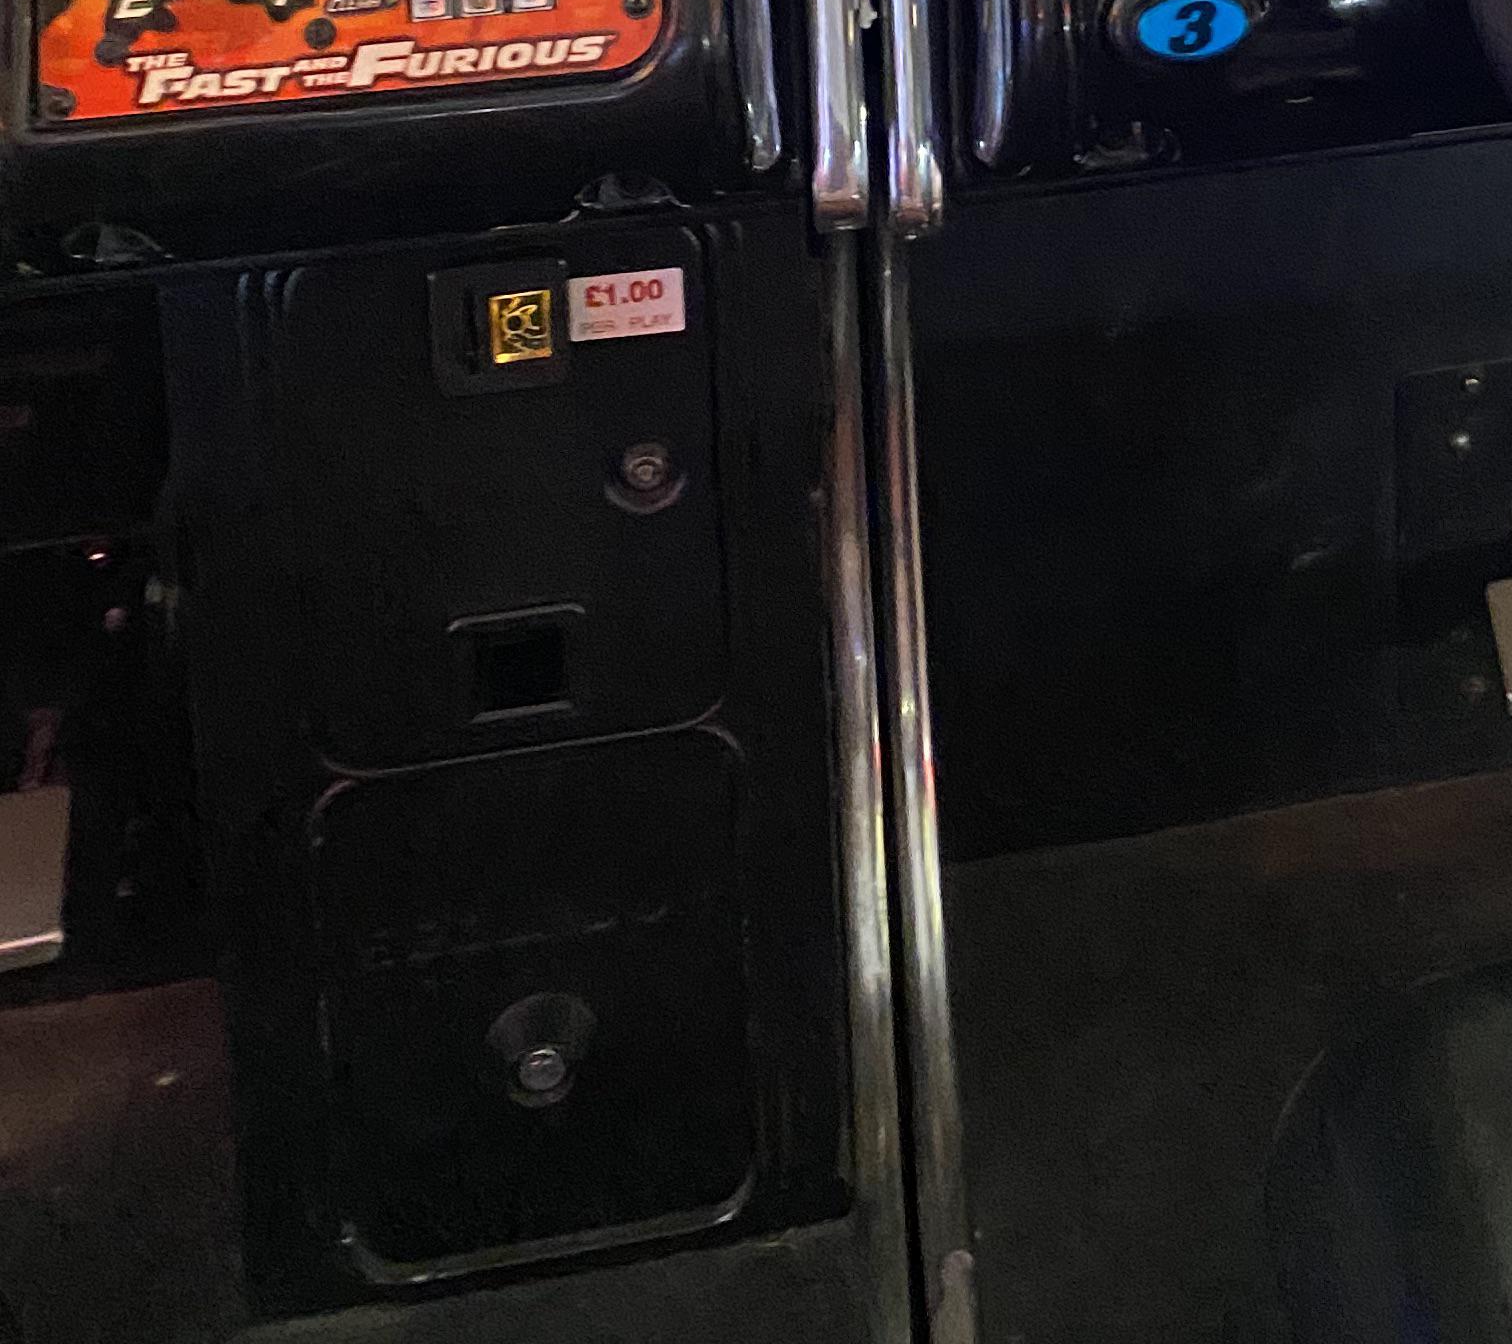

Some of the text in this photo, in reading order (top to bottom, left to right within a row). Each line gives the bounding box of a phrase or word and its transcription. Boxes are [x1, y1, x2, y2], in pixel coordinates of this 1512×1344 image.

[1168, 0, 1217, 54] 3
[126, 36, 606, 105] THE FAST AND THE FURIOUS
[584, 278, 664, 308] £1.00
[628, 314, 672, 329] PLAY
